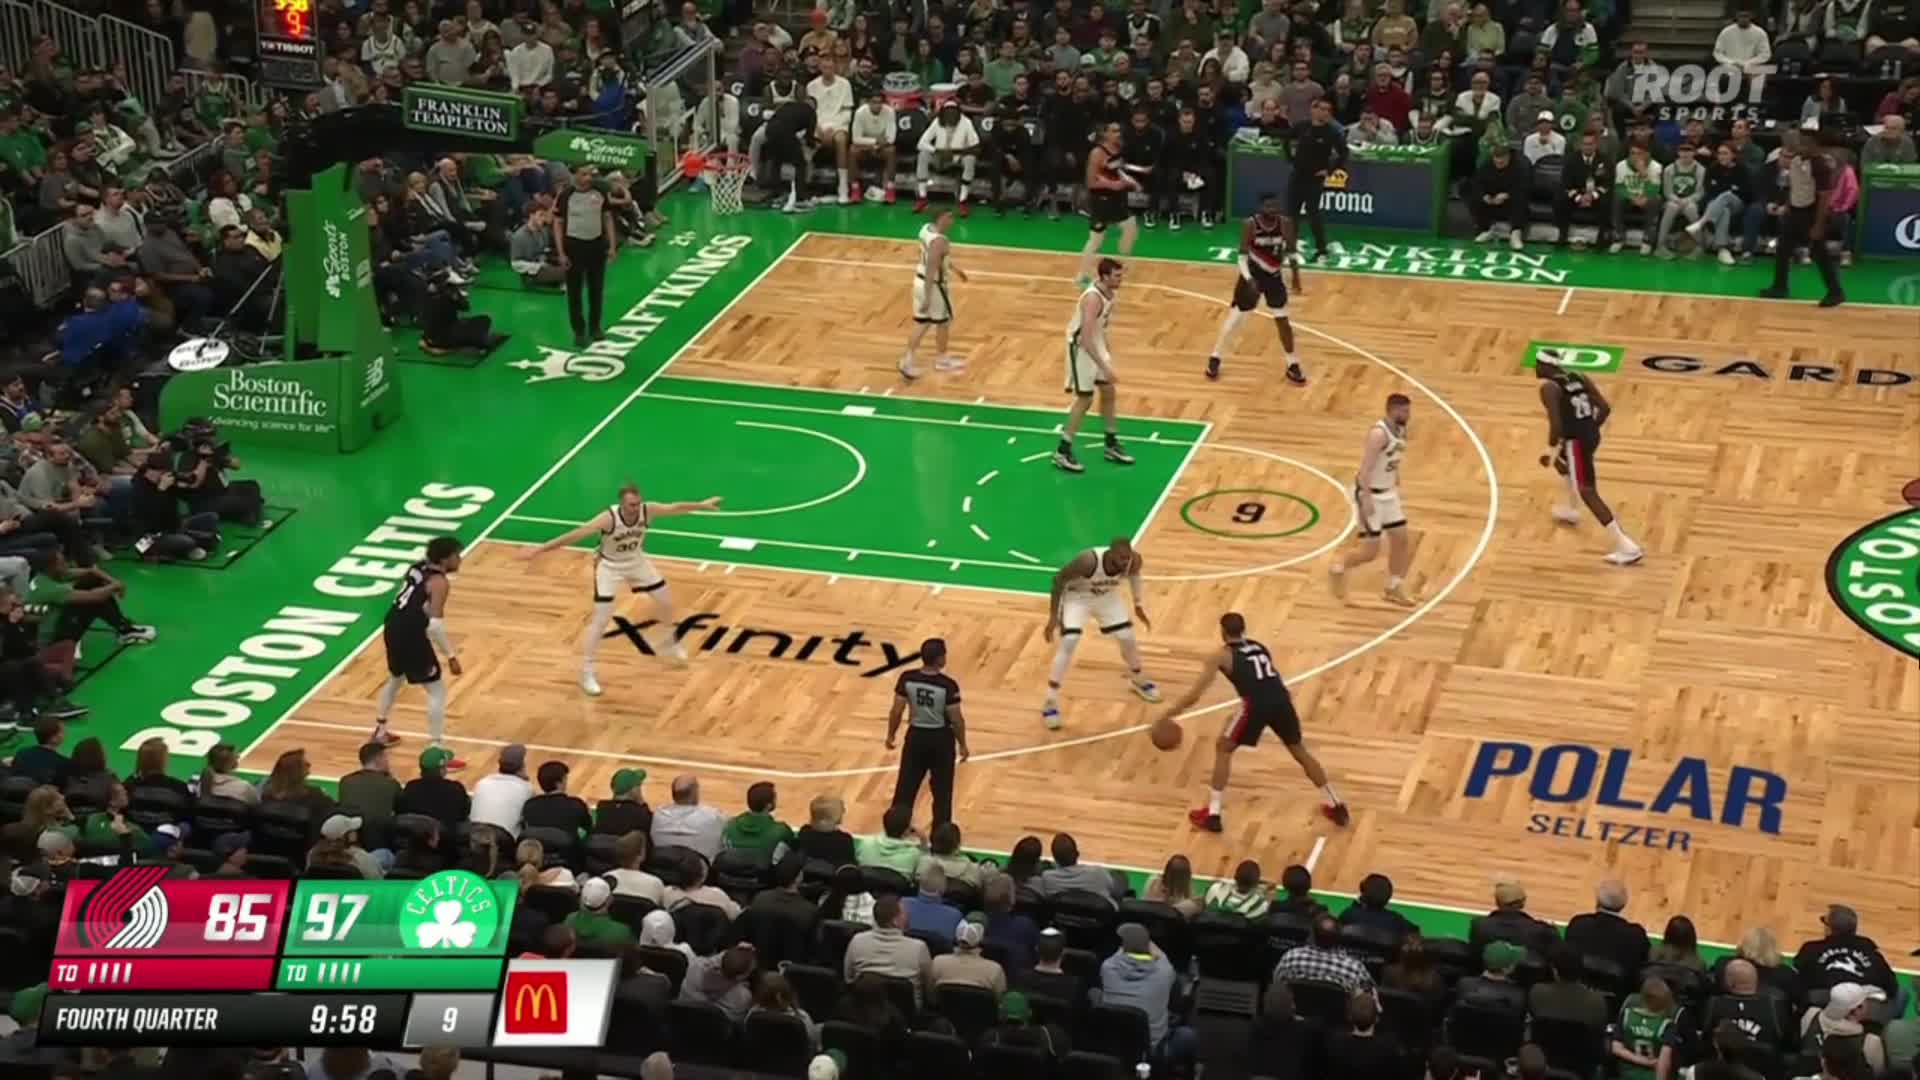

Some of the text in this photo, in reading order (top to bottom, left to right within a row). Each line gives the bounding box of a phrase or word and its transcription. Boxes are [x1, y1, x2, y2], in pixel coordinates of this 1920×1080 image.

[411, 110, 509, 135] TEMPLETON
[416, 97, 502, 120] FRANKLIN
[585, 152, 628, 165] BOSTON
[338, 232, 351, 281] BOSTON
[563, 234, 753, 382] DRAFTKINGS
[230, 368, 300, 397] Boston
[1641, 355, 1913, 386] GARD
[213, 383, 327, 417] Scientific
[261, 420, 295, 431] science
[1232, 502, 1266, 524] 9
[313, 482, 495, 598] CELTICS
[602, 613, 922, 678] xfinity
[119, 605, 362, 757] BOSTON
[1246, 653, 1278, 680] 72
[1463, 740, 1788, 836] POLAR
[1526, 813, 1692, 852] SELTZER
